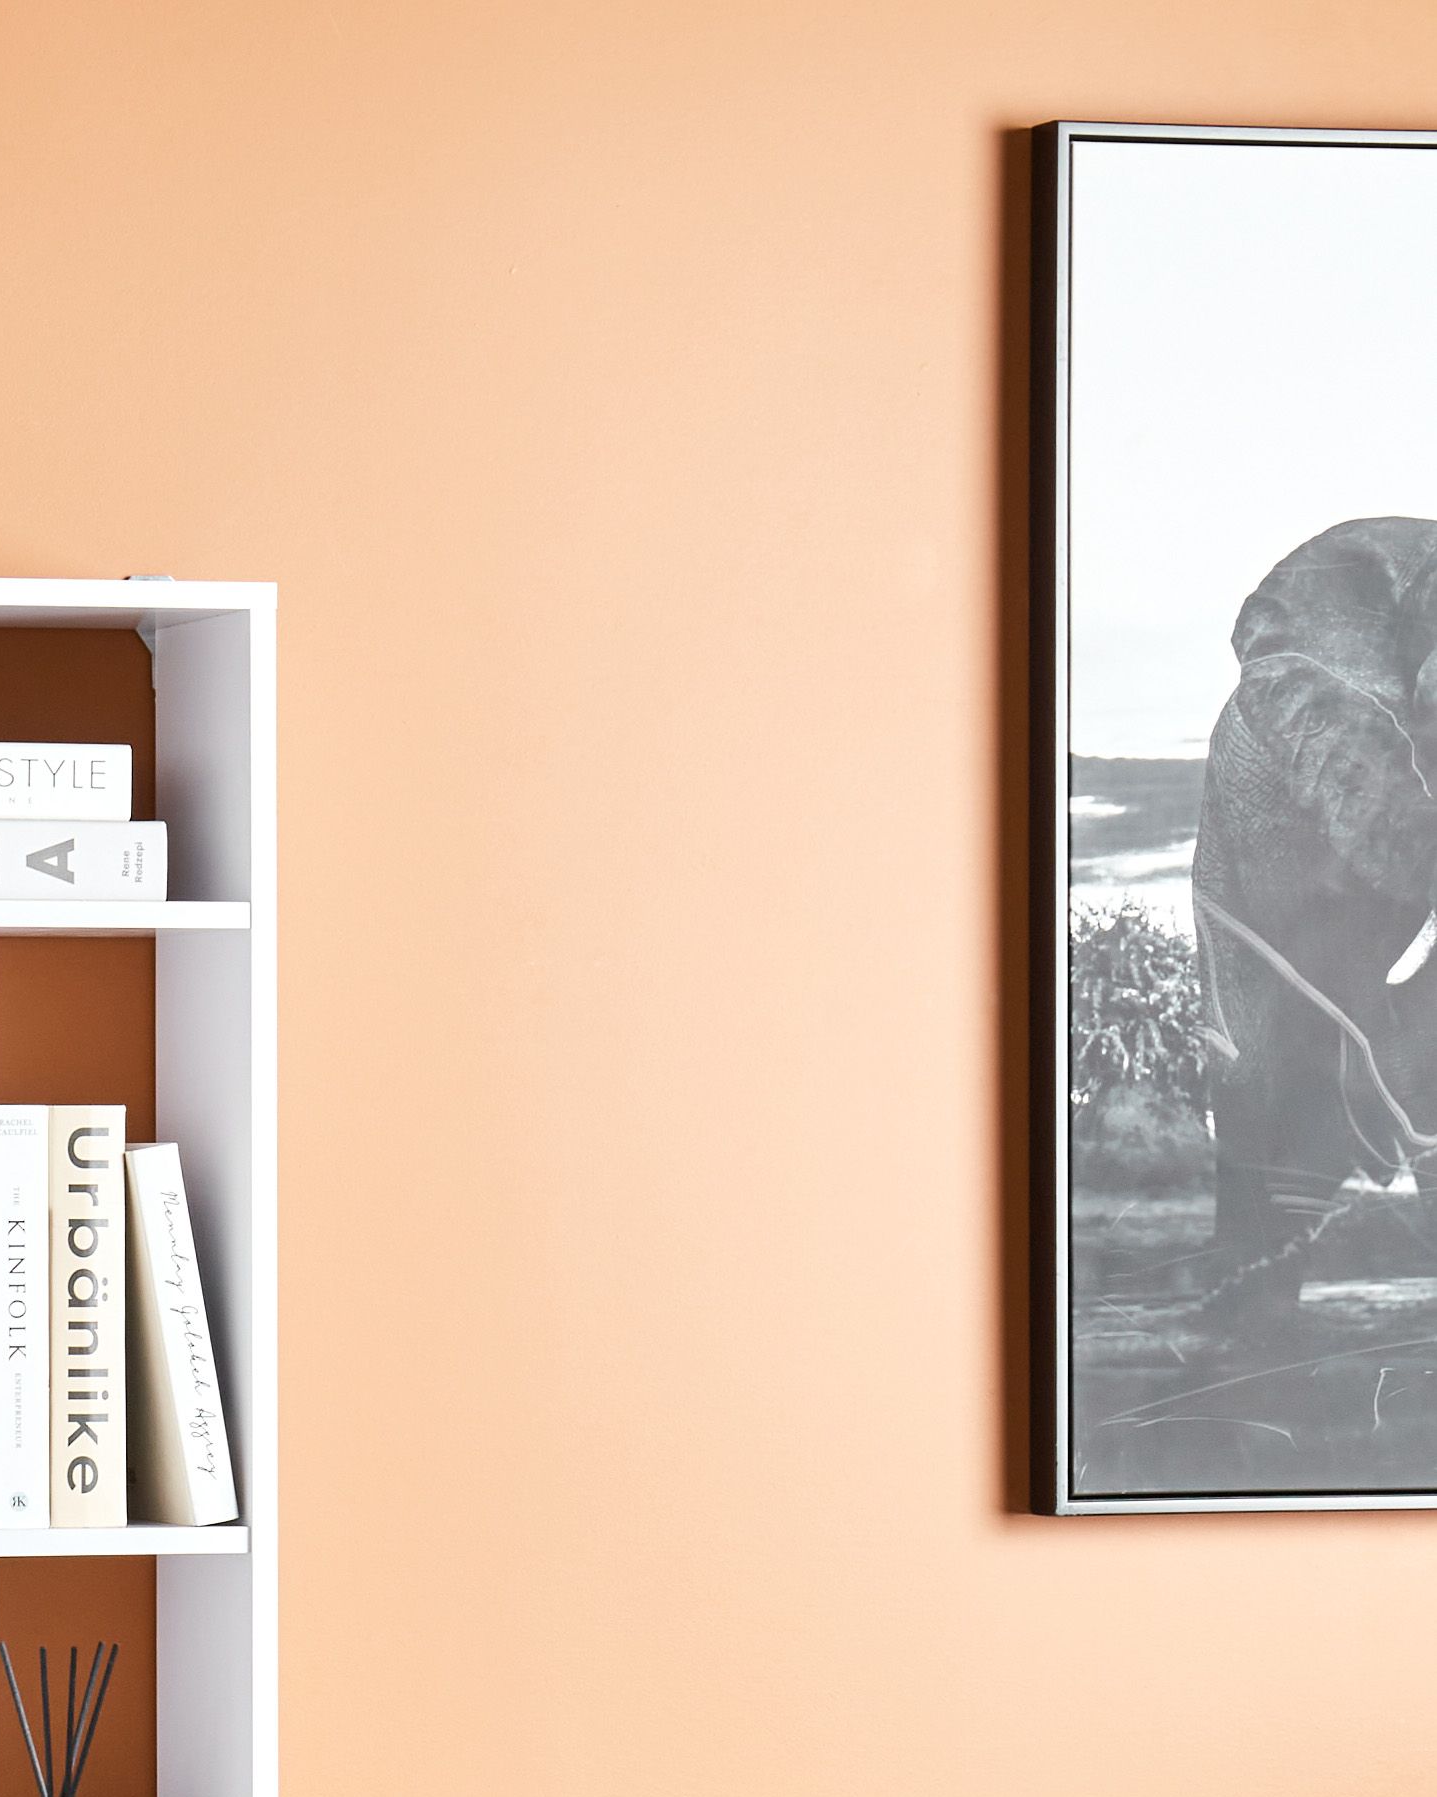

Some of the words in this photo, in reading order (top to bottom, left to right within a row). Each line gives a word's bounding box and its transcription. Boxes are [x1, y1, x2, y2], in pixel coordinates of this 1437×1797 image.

[12, 1186, 20, 1206] THE
[8, 1220, 27, 1361] KINFOLK
[67, 1127, 109, 1494] Urbänlike
